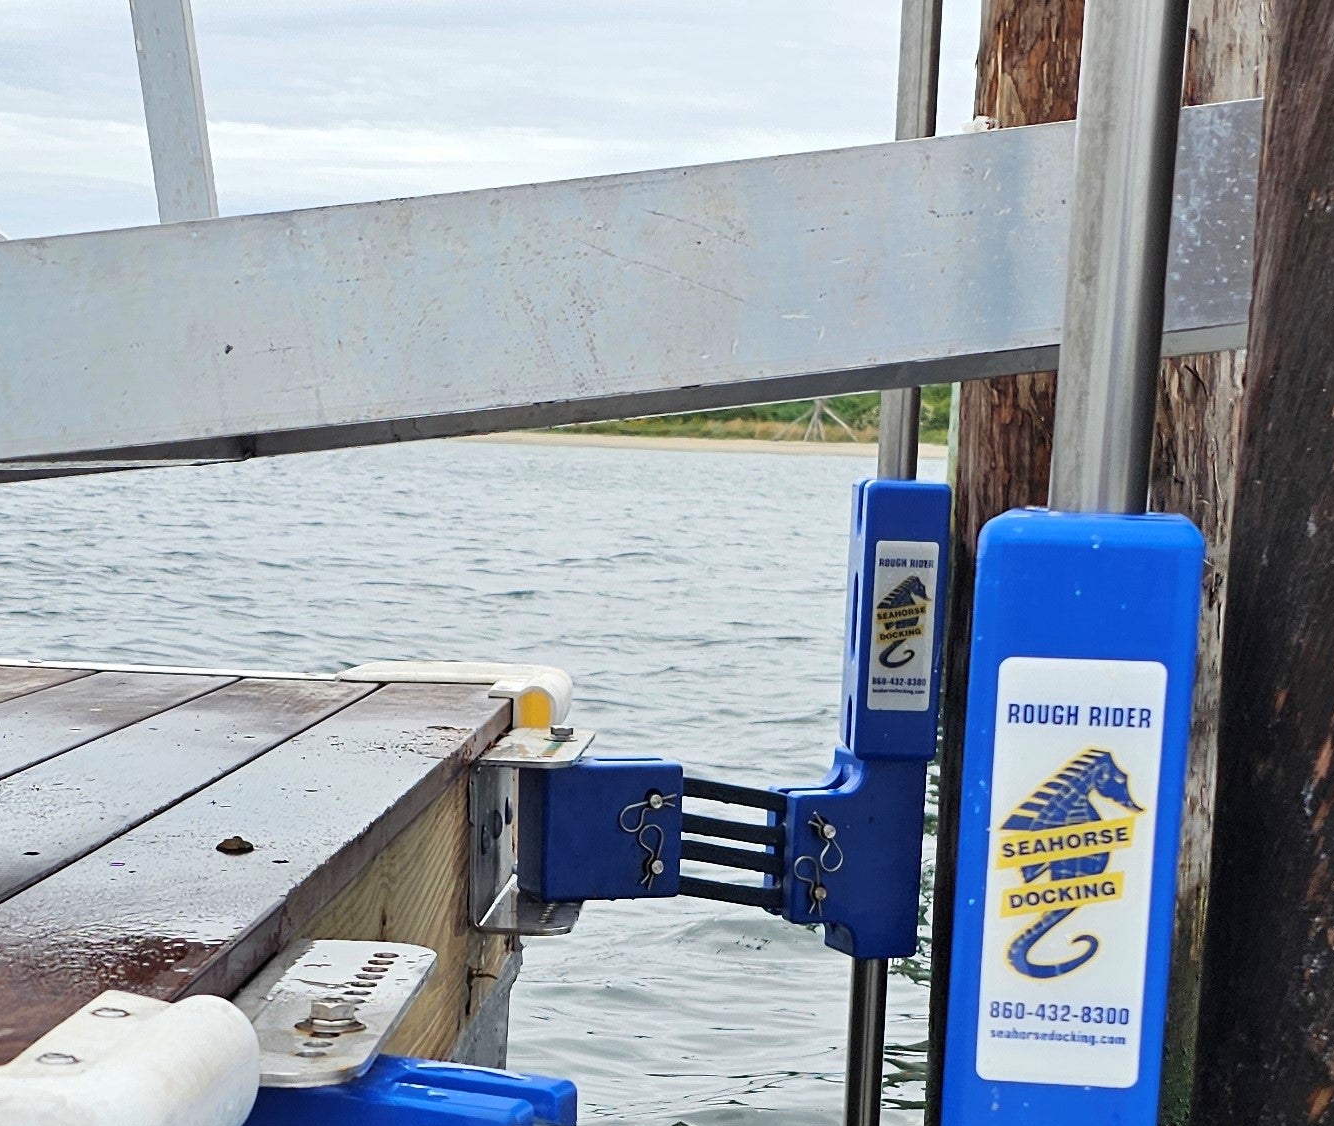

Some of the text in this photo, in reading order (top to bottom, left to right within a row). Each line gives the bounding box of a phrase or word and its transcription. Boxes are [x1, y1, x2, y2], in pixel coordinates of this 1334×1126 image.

[878, 557, 934, 569] ROUGH RIDER
[876, 605, 927, 620] SEAHORSE
[879, 627, 922, 641] DOCKING
[1006, 703, 1152, 729] ROUGH RIDER
[1000, 825, 1130, 858] SEAHORSE
[1008, 880, 1117, 910] DOCKING
[989, 1001, 1131, 1026] 860-432-8300
[989, 1027, 1127, 1046] seahorsedocking.com
